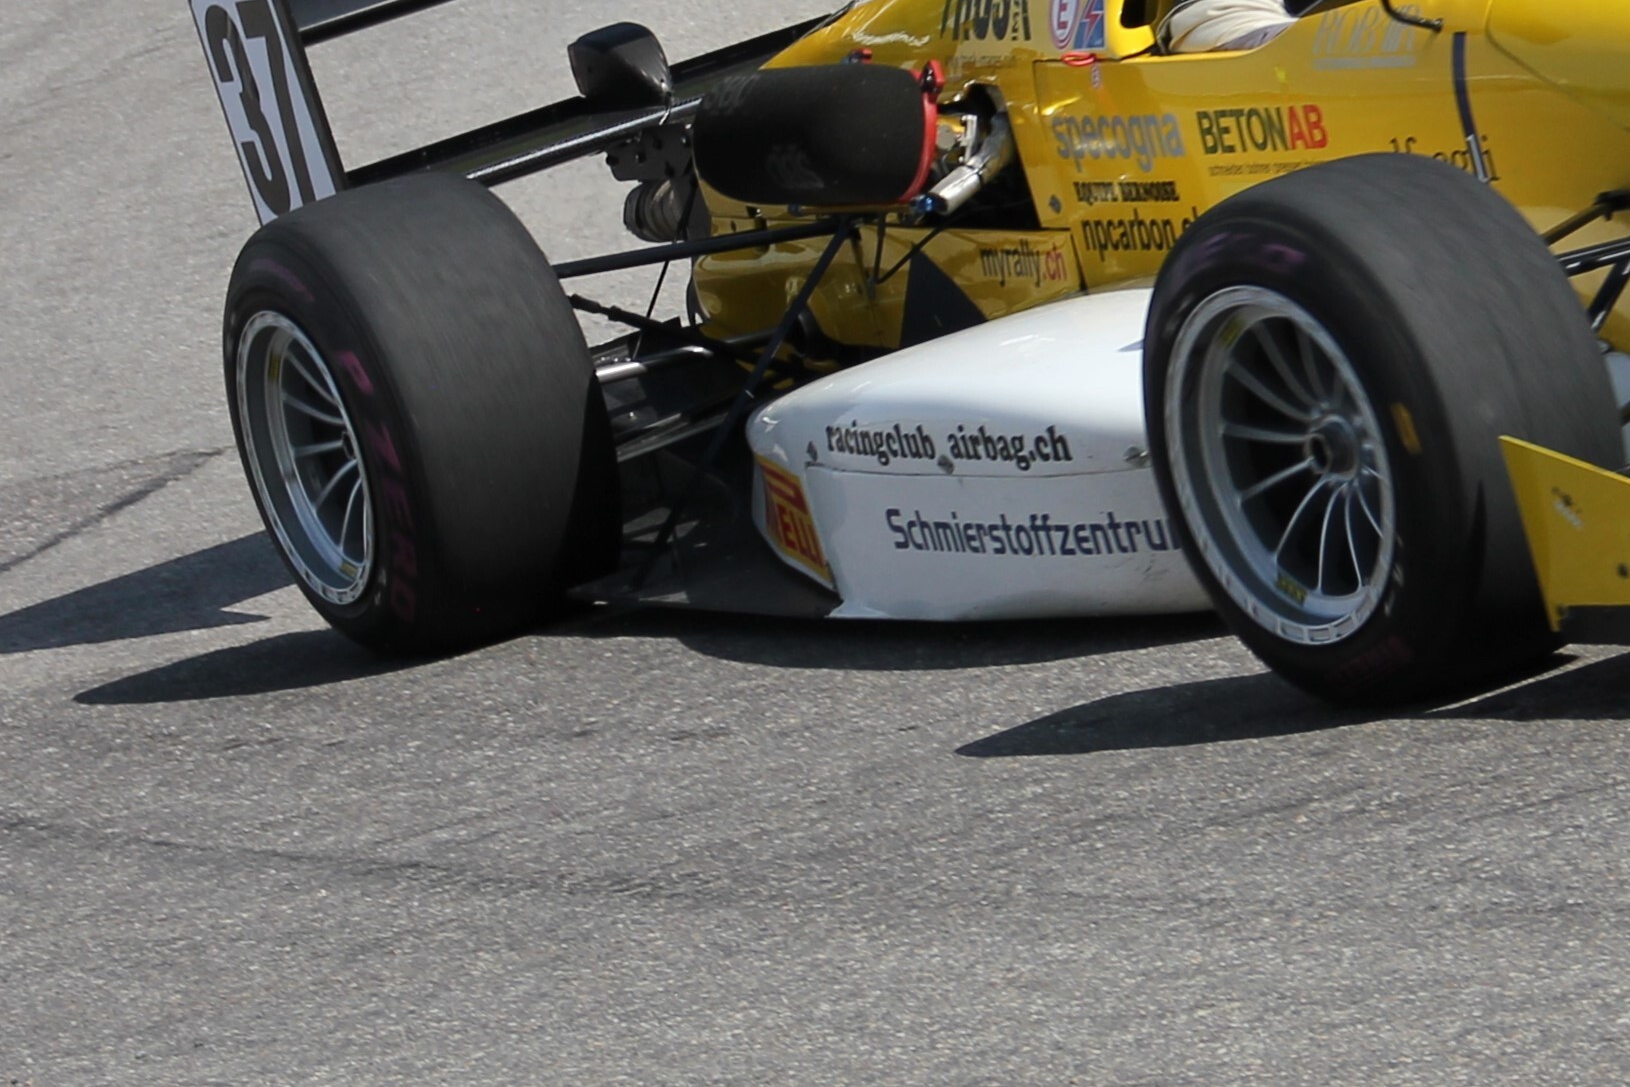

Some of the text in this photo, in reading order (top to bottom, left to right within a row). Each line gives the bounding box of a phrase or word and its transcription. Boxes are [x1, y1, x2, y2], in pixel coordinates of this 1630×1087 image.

[1051, 112, 1187, 173] specogna
[1196, 103, 1329, 155] BETONAB
[980, 238, 1068, 288] myrally.ch
[826, 419, 1073, 472] racingclub airbag.ch
[886, 508, 1184, 557] Schmierstoffzentru
